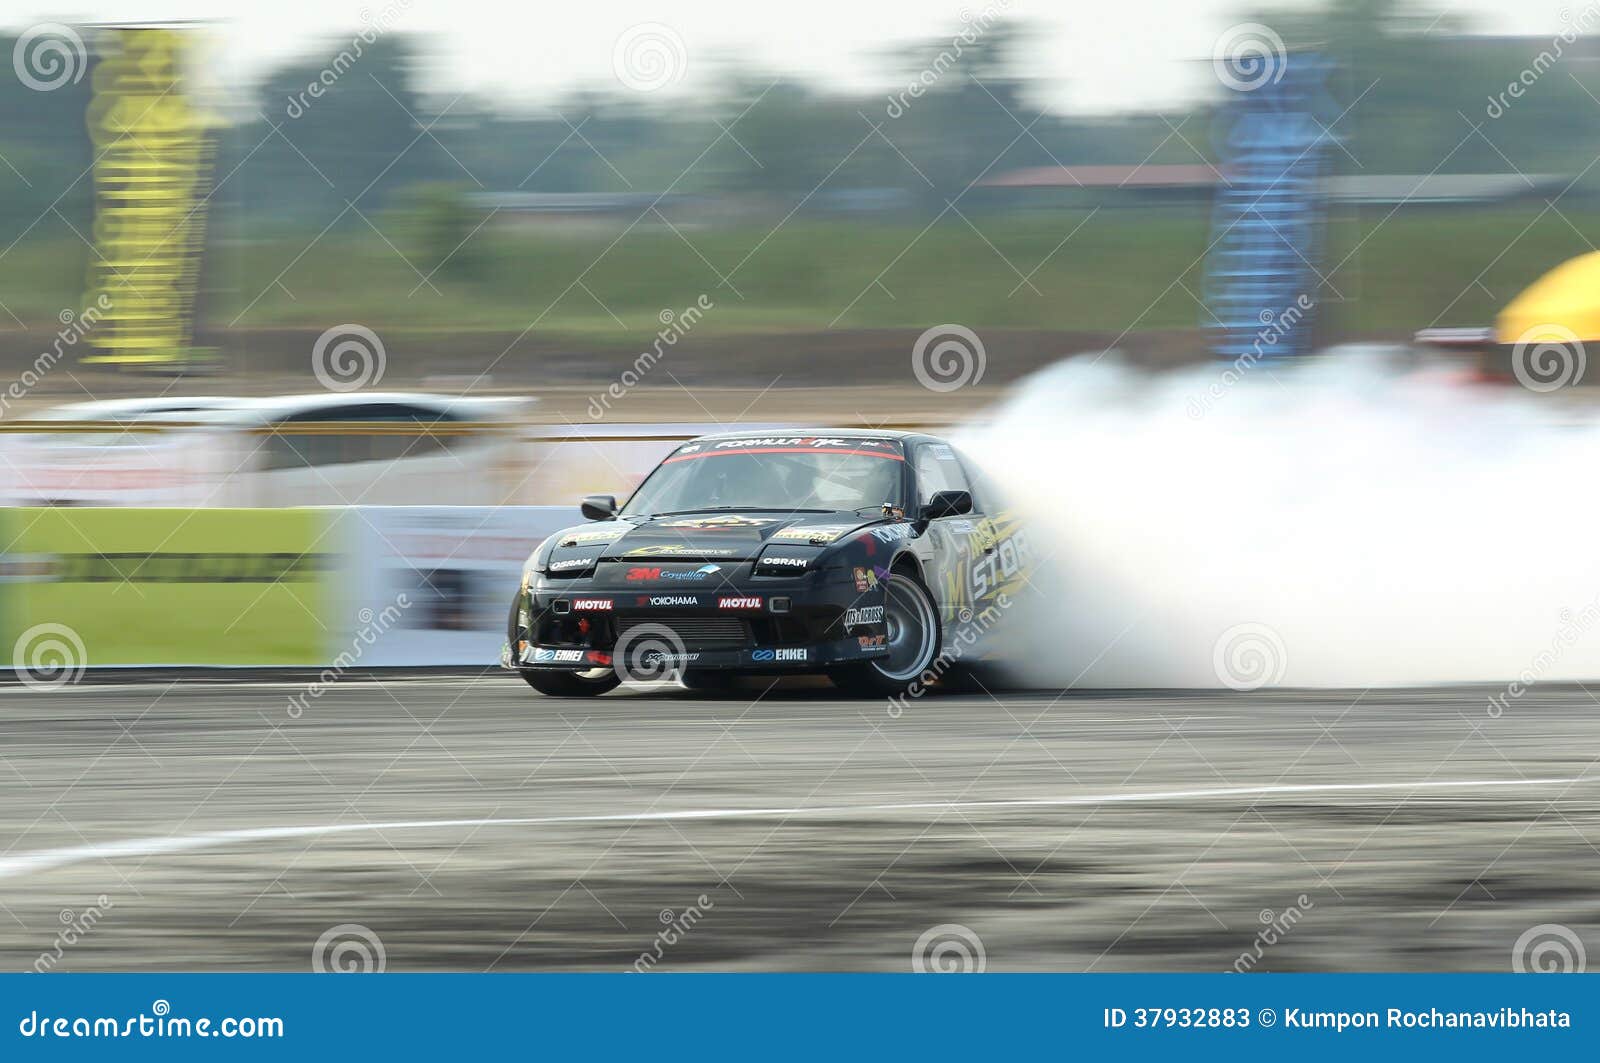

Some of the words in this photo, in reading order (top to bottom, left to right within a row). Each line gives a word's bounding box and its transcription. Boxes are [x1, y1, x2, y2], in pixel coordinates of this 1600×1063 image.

[552, 558, 592, 570] OSRAM
[763, 557, 807, 568] OSRAM
[626, 567, 662, 581] 3M
[574, 600, 612, 610] MOTUL
[649, 596, 698, 606] YOKOHAMA
[719, 598, 761, 608] MOTUL
[553, 650, 584, 662] ENKEI
[775, 649, 807, 661] ENKEI
